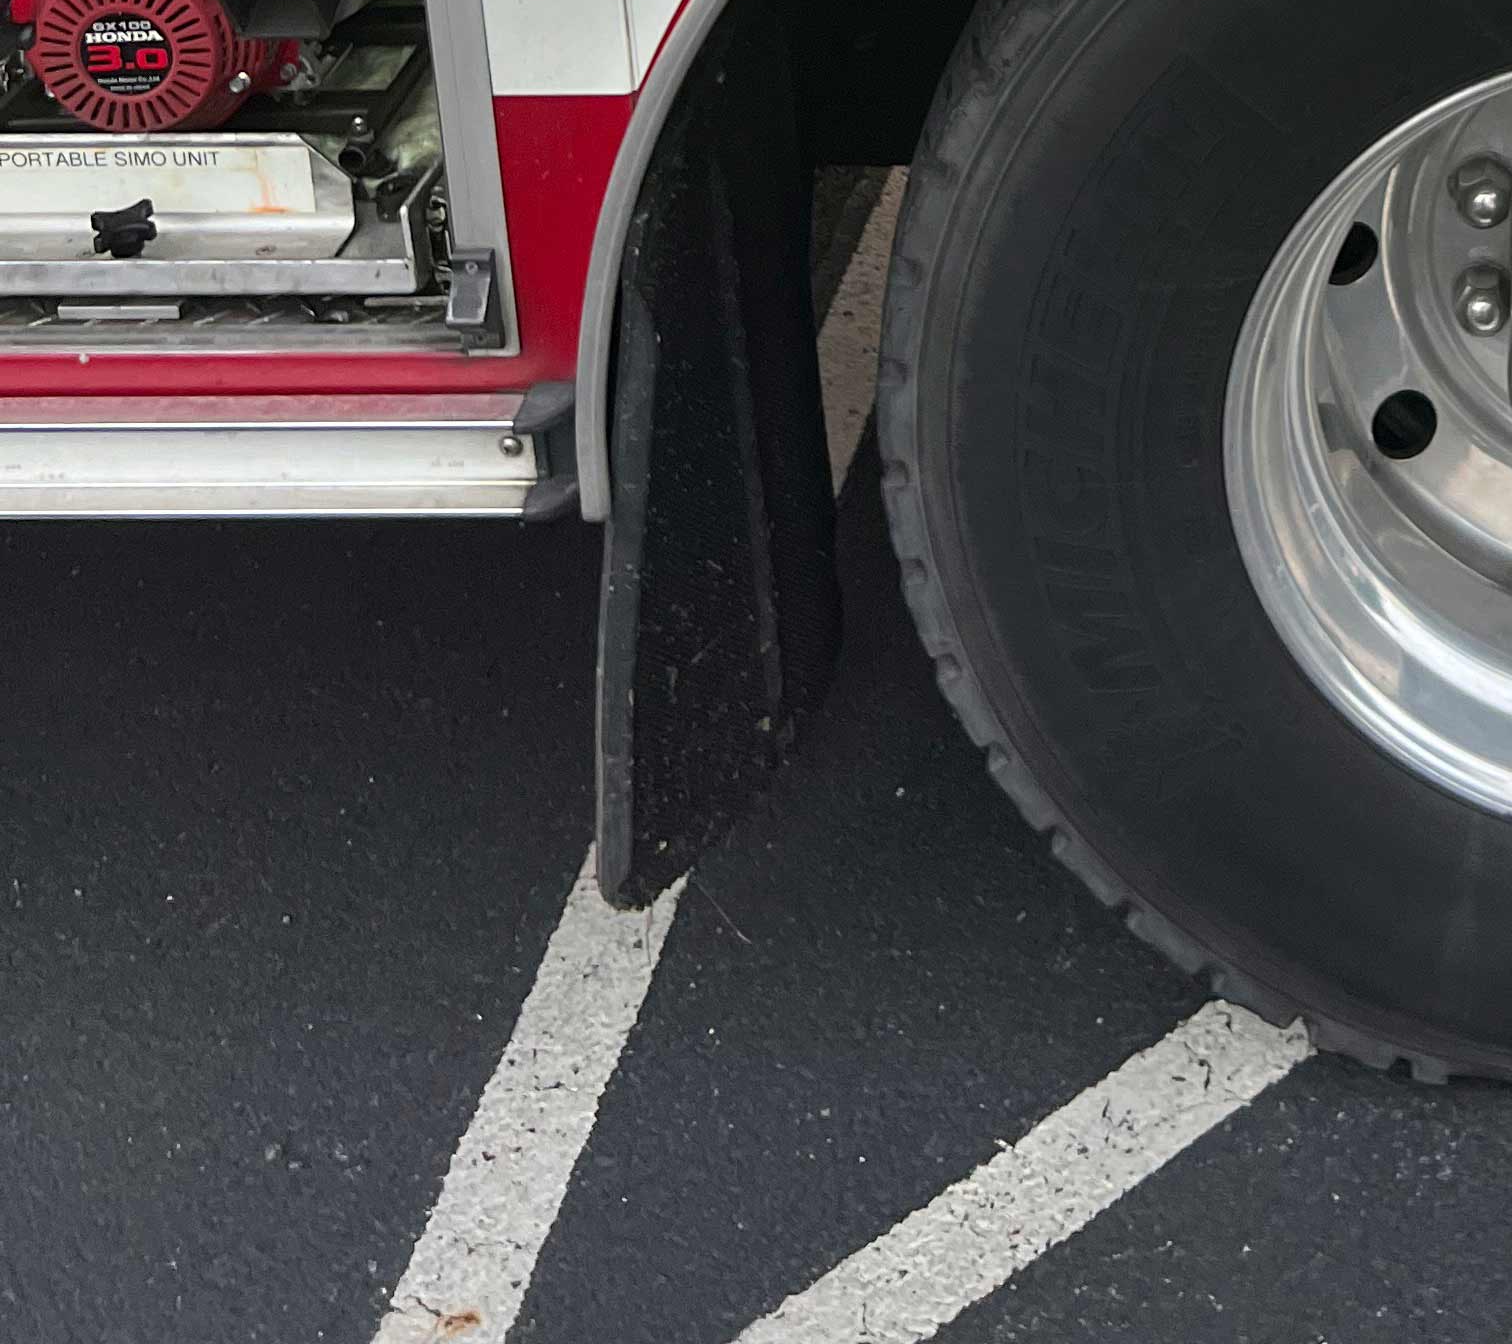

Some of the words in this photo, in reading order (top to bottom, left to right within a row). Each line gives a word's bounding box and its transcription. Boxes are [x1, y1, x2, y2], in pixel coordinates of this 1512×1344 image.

[92, 20, 151, 31] GX100
[85, 30, 164, 44] HONDA
[87, 45, 168, 72] 3.0
[0, 151, 108, 168] PORTABLE
[114, 151, 167, 167] SIMO
[173, 150, 220, 167] UNIT
